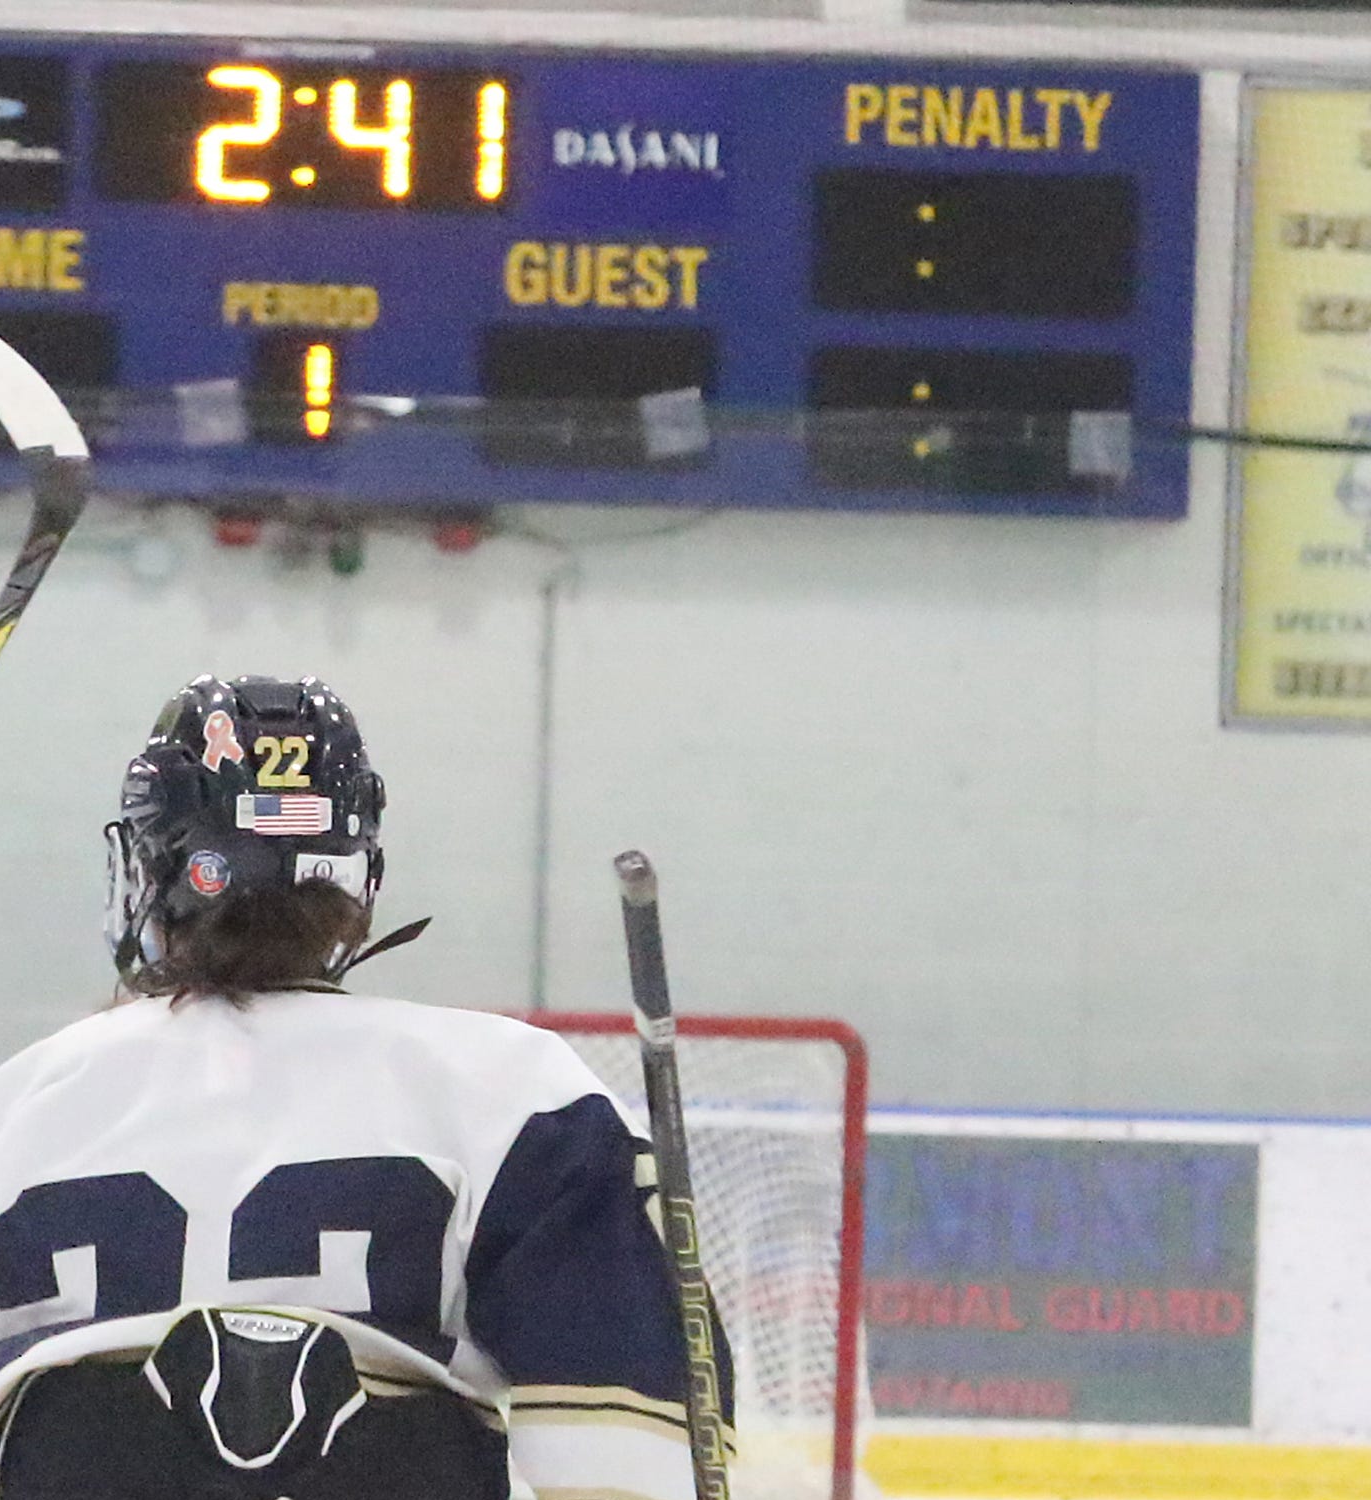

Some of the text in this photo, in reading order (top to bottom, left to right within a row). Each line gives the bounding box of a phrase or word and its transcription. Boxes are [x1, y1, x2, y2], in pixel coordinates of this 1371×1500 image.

[196, 65, 506, 203] 2:41
[845, 84, 1113, 152] PENALTY
[552, 126, 721, 174] DASANI
[222, 281, 380, 330] PERIOD
[503, 241, 709, 310] GUEST
[303, 342, 334, 438] 1
[254, 735, 311, 788] 22
[1046, 1287, 1246, 1337] GUARD
